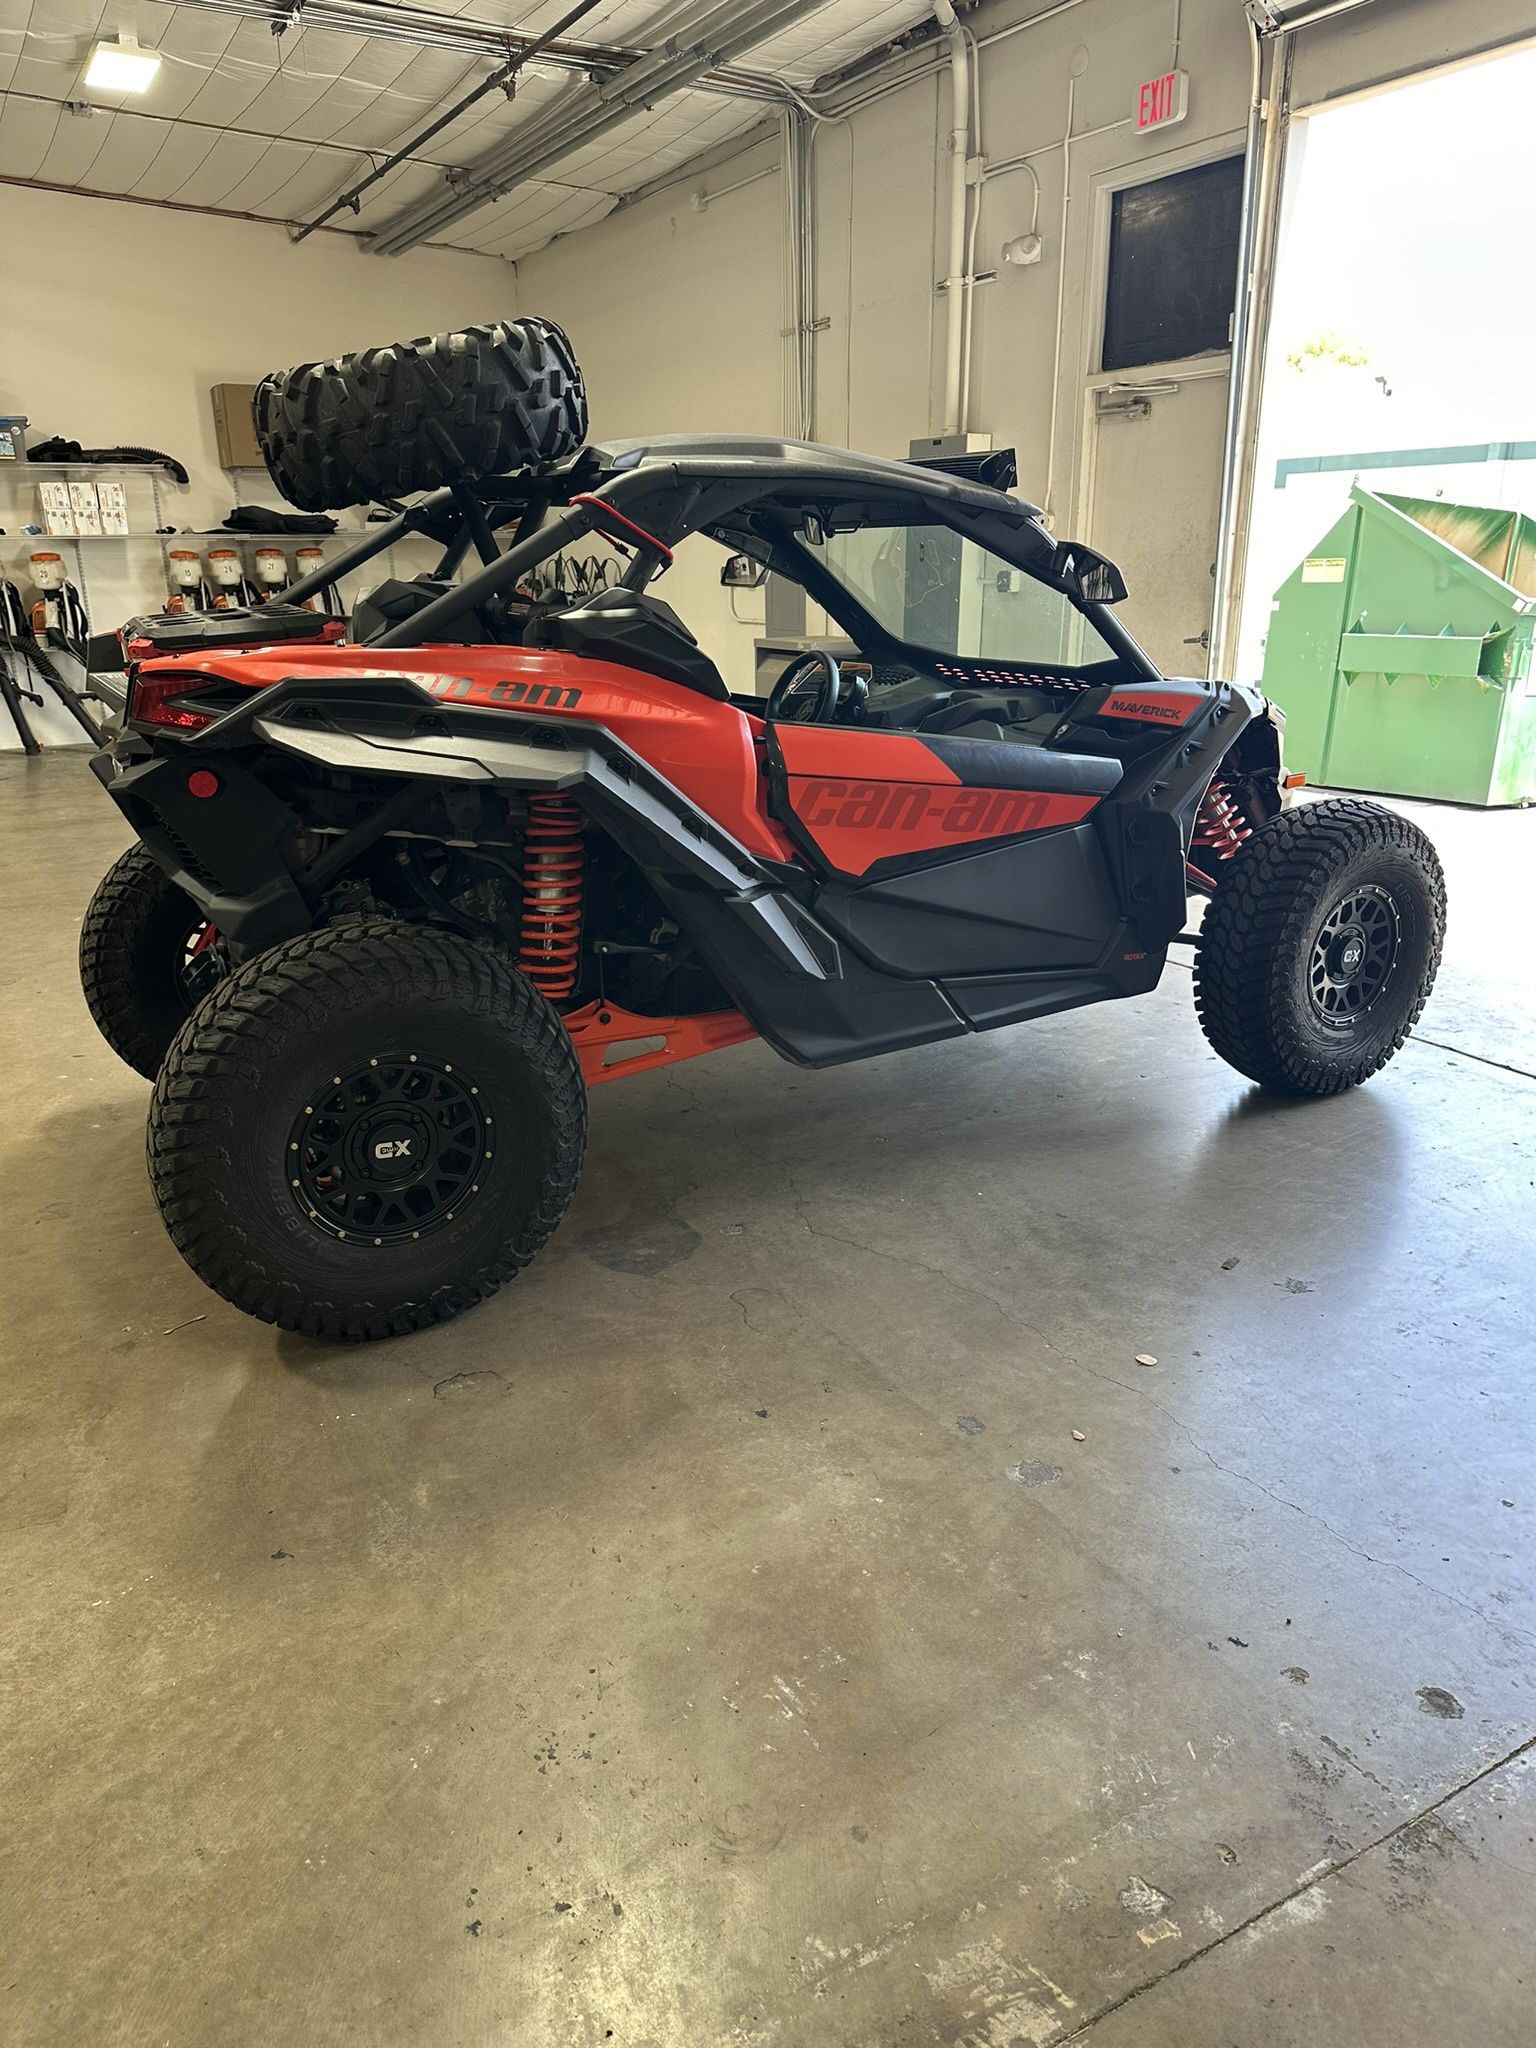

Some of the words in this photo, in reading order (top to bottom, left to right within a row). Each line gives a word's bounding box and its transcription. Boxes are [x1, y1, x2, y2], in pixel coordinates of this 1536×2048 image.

[1138, 73, 1176, 128] EXIT
[363, 669, 583, 708] an-am
[1110, 700, 1182, 720] MAVERICK
[797, 780, 1050, 834] can-am
